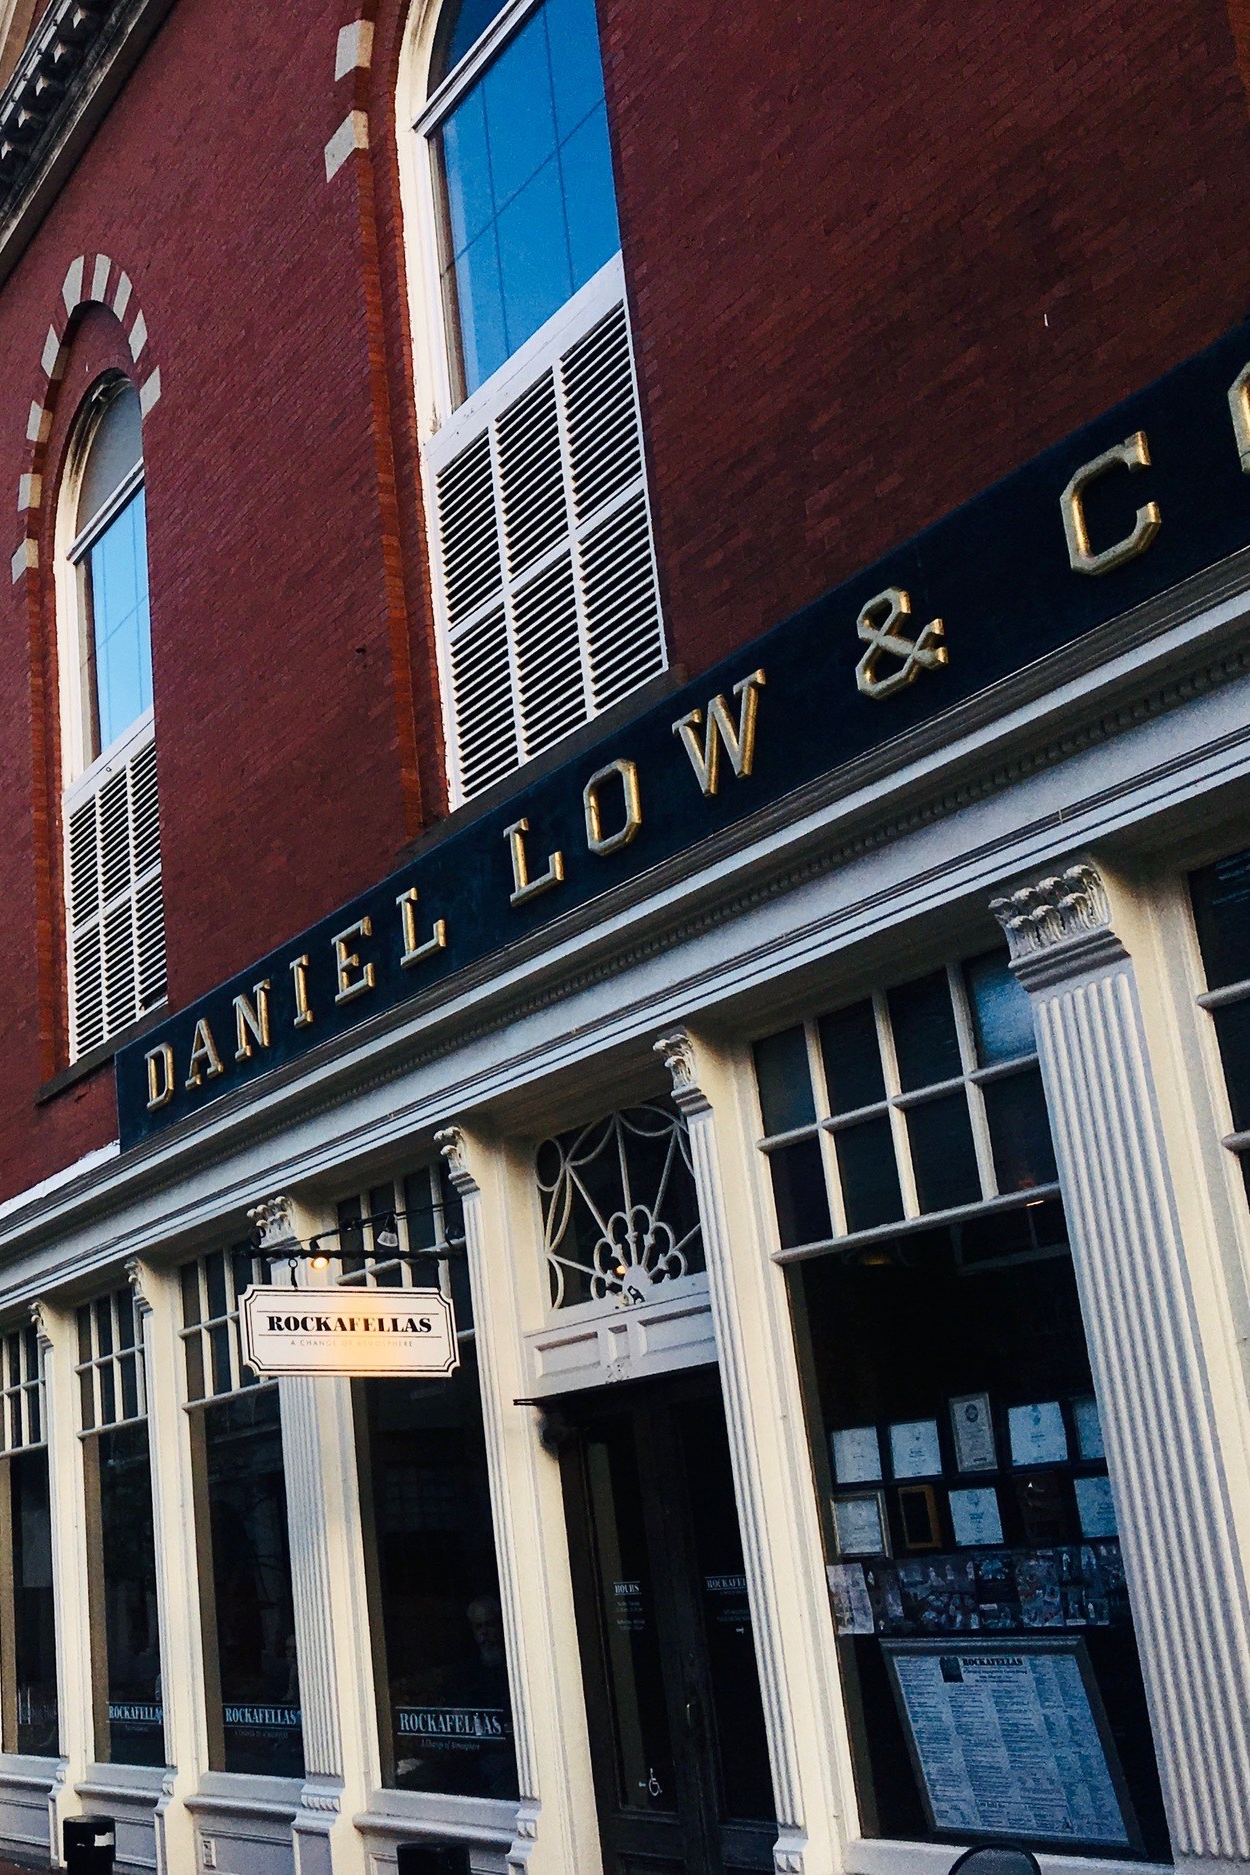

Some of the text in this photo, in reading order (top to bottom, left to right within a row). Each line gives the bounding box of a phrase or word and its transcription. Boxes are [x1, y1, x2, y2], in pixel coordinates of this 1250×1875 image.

[145, 361, 1250, 1110] DANIEL LOW & C
[267, 1316, 432, 1333] ROCKAFELLAS
[962, 1657, 1023, 1667] ROCKAFELLAS
[109, 1705, 162, 1724] ROCKAFELLA
[225, 1707, 297, 1725] ROCKAFELLAS
